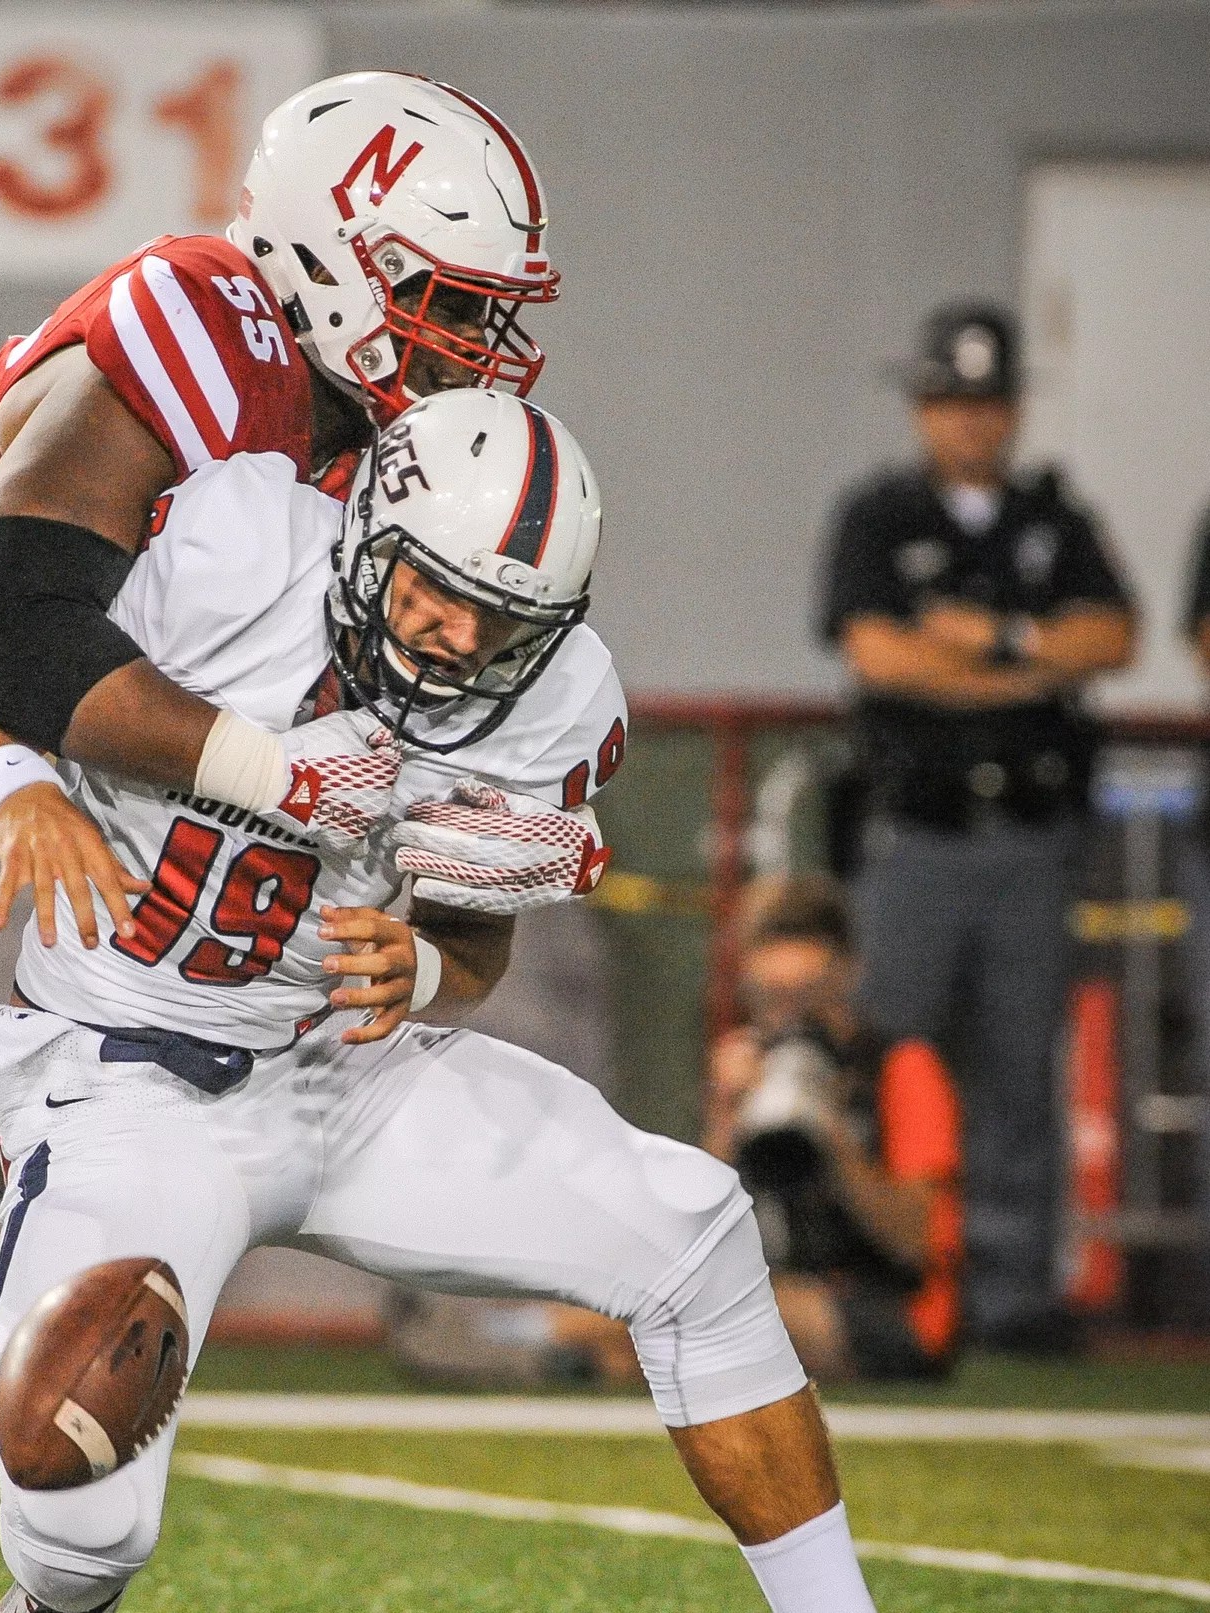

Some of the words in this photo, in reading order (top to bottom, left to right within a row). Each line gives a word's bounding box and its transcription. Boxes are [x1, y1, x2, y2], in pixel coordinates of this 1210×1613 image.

[333, 124, 424, 212] N
[211, 275, 289, 366] 55
[110, 815, 321, 987] 19
